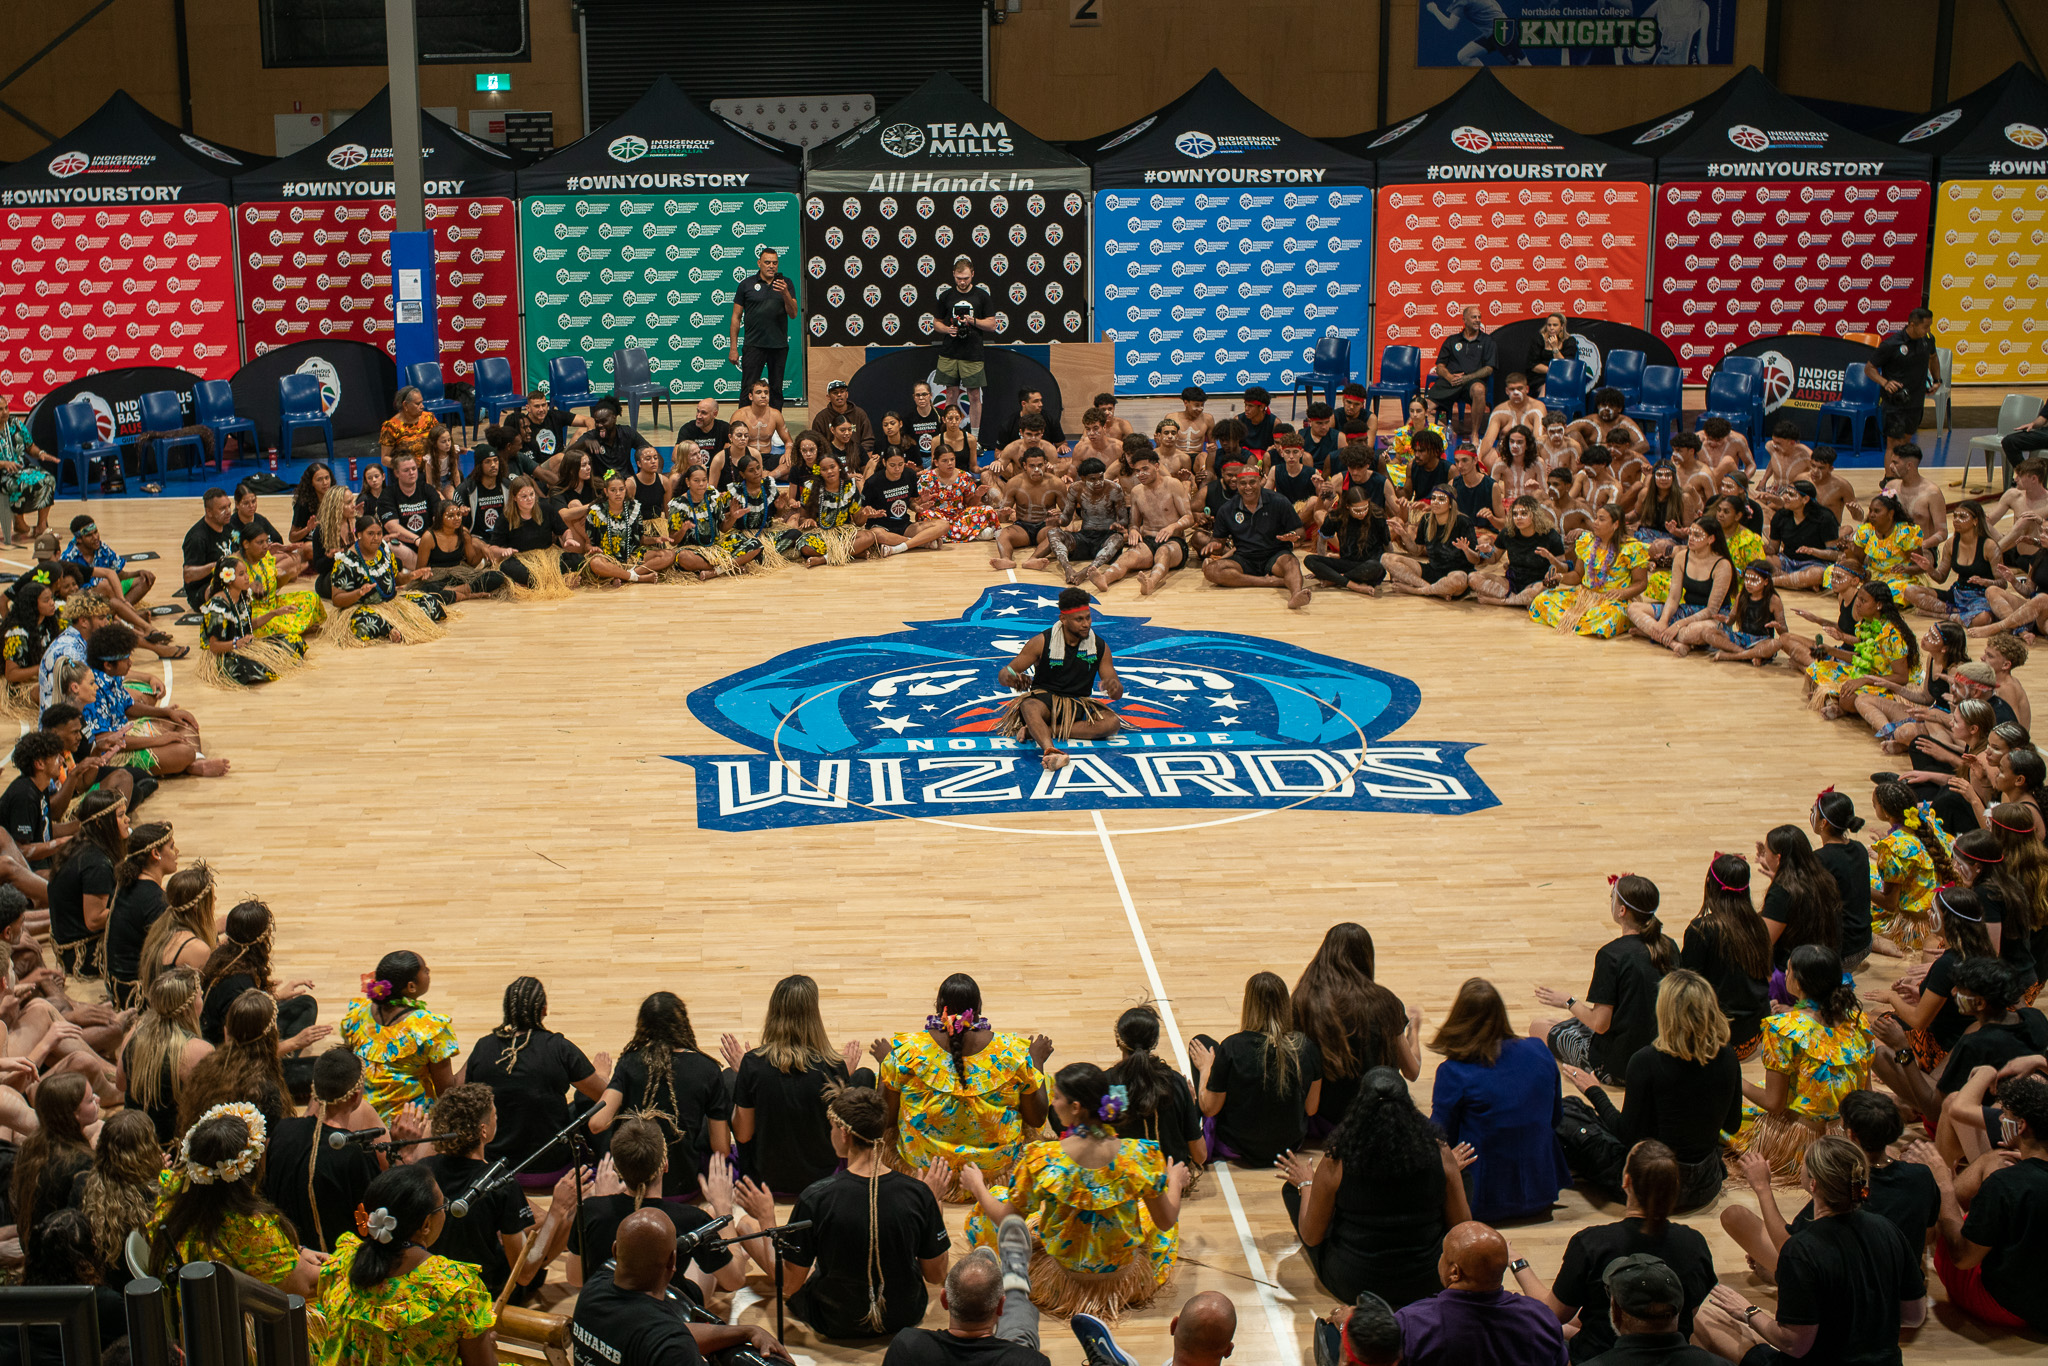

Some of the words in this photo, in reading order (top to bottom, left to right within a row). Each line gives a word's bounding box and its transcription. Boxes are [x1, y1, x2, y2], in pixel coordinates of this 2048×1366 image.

[1521, 7, 1561, 17] Northside
[1562, 7, 1598, 17] Christian
[1600, 7, 1631, 18] College
[1519, 20, 1656, 46] KNIGHTS
[927, 122, 1009, 138] TEAM
[929, 138, 1014, 154] MILLS
[93, 154, 157, 162] INDIGENOUS
[1144, 168, 1326, 183] #OWNYOURSTORY
[1427, 163, 1607, 180] #OWNYOURSTORY
[1707, 162, 1884, 177] #OWNYOURSTORY
[566, 174, 750, 191] #OWNYOURSTORY
[867, 172, 906, 193] All
[911, 171, 1001, 192] Hands
[1008, 172, 1035, 192] In
[1, 186, 182, 206] #OWNYOURSTORY
[1798, 366, 1845, 381] INDIGE
[1797, 377, 1844, 392] BASKET
[716, 751, 1473, 818] WIZARDS
